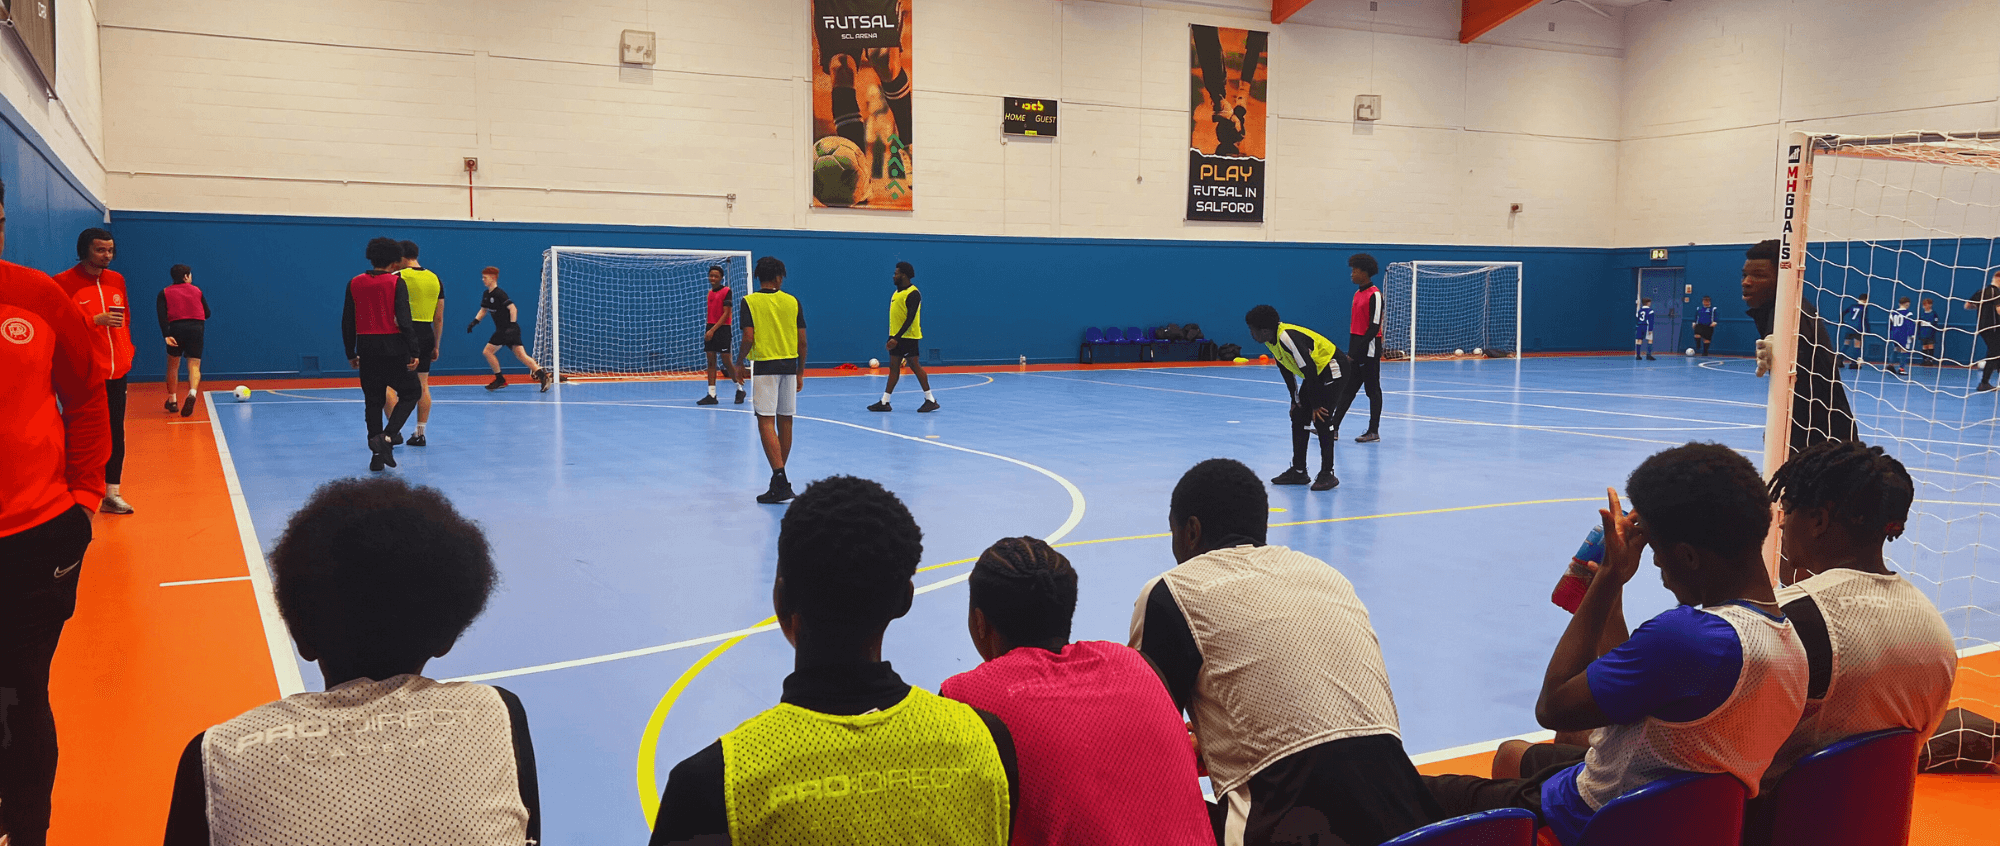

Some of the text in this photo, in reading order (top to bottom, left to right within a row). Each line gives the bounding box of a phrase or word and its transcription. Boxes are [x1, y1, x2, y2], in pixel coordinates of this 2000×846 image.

[822, 15, 895, 29] FUTSAL
[1004, 112, 1057, 123] HOME GUEST
[1200, 164, 1253, 182] PLAY
[1192, 185, 1257, 198] FUTSAL IN
[1196, 201, 1254, 213] SALFORD
[1639, 311, 1646, 321] 3
[1851, 307, 1860, 320] 7
[1893, 314, 1904, 327] 10
